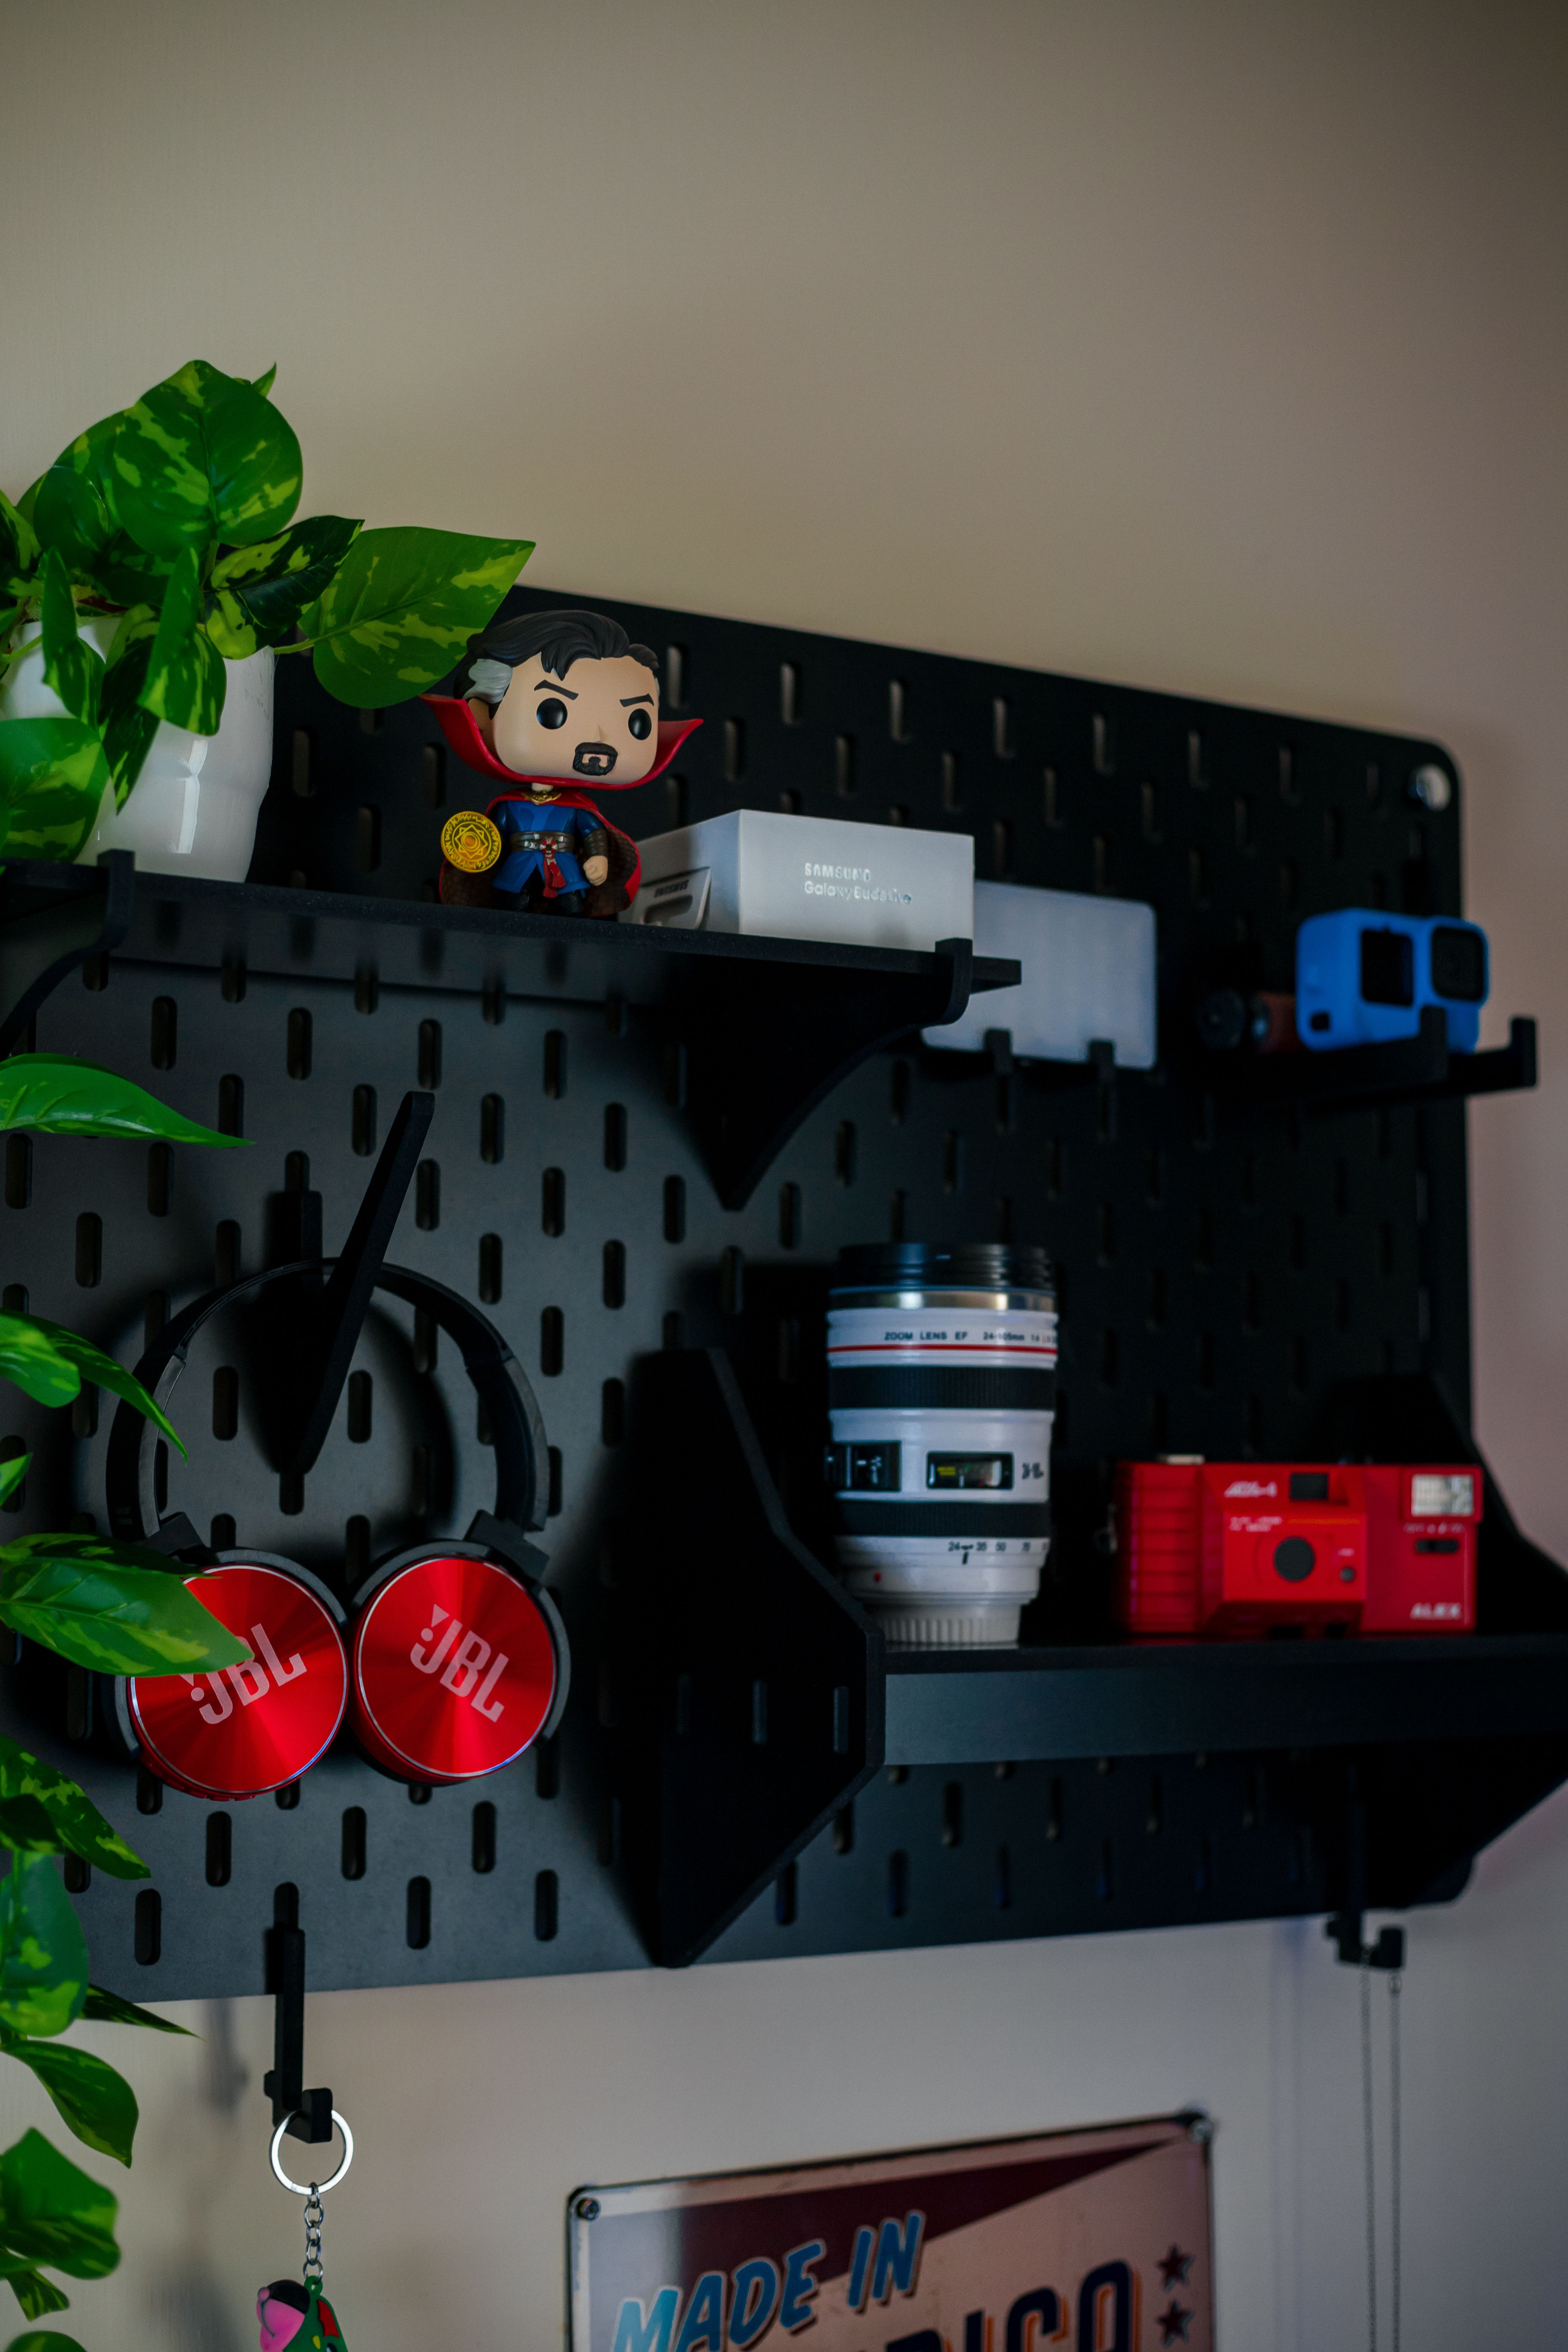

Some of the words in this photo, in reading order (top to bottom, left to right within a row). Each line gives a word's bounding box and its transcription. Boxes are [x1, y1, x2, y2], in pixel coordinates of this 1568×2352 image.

[804, 880, 851, 902] Galaxy
[884, 1331, 913, 1341] ZOOM
[920, 1331, 948, 1341] LENS
[955, 1331, 968, 1341] EF
[948, 1541, 960, 1552] 24
[409, 1603, 510, 1724] JBL
[611, 2240, 825, 2352] MADE
[847, 2212, 923, 2309] IN
